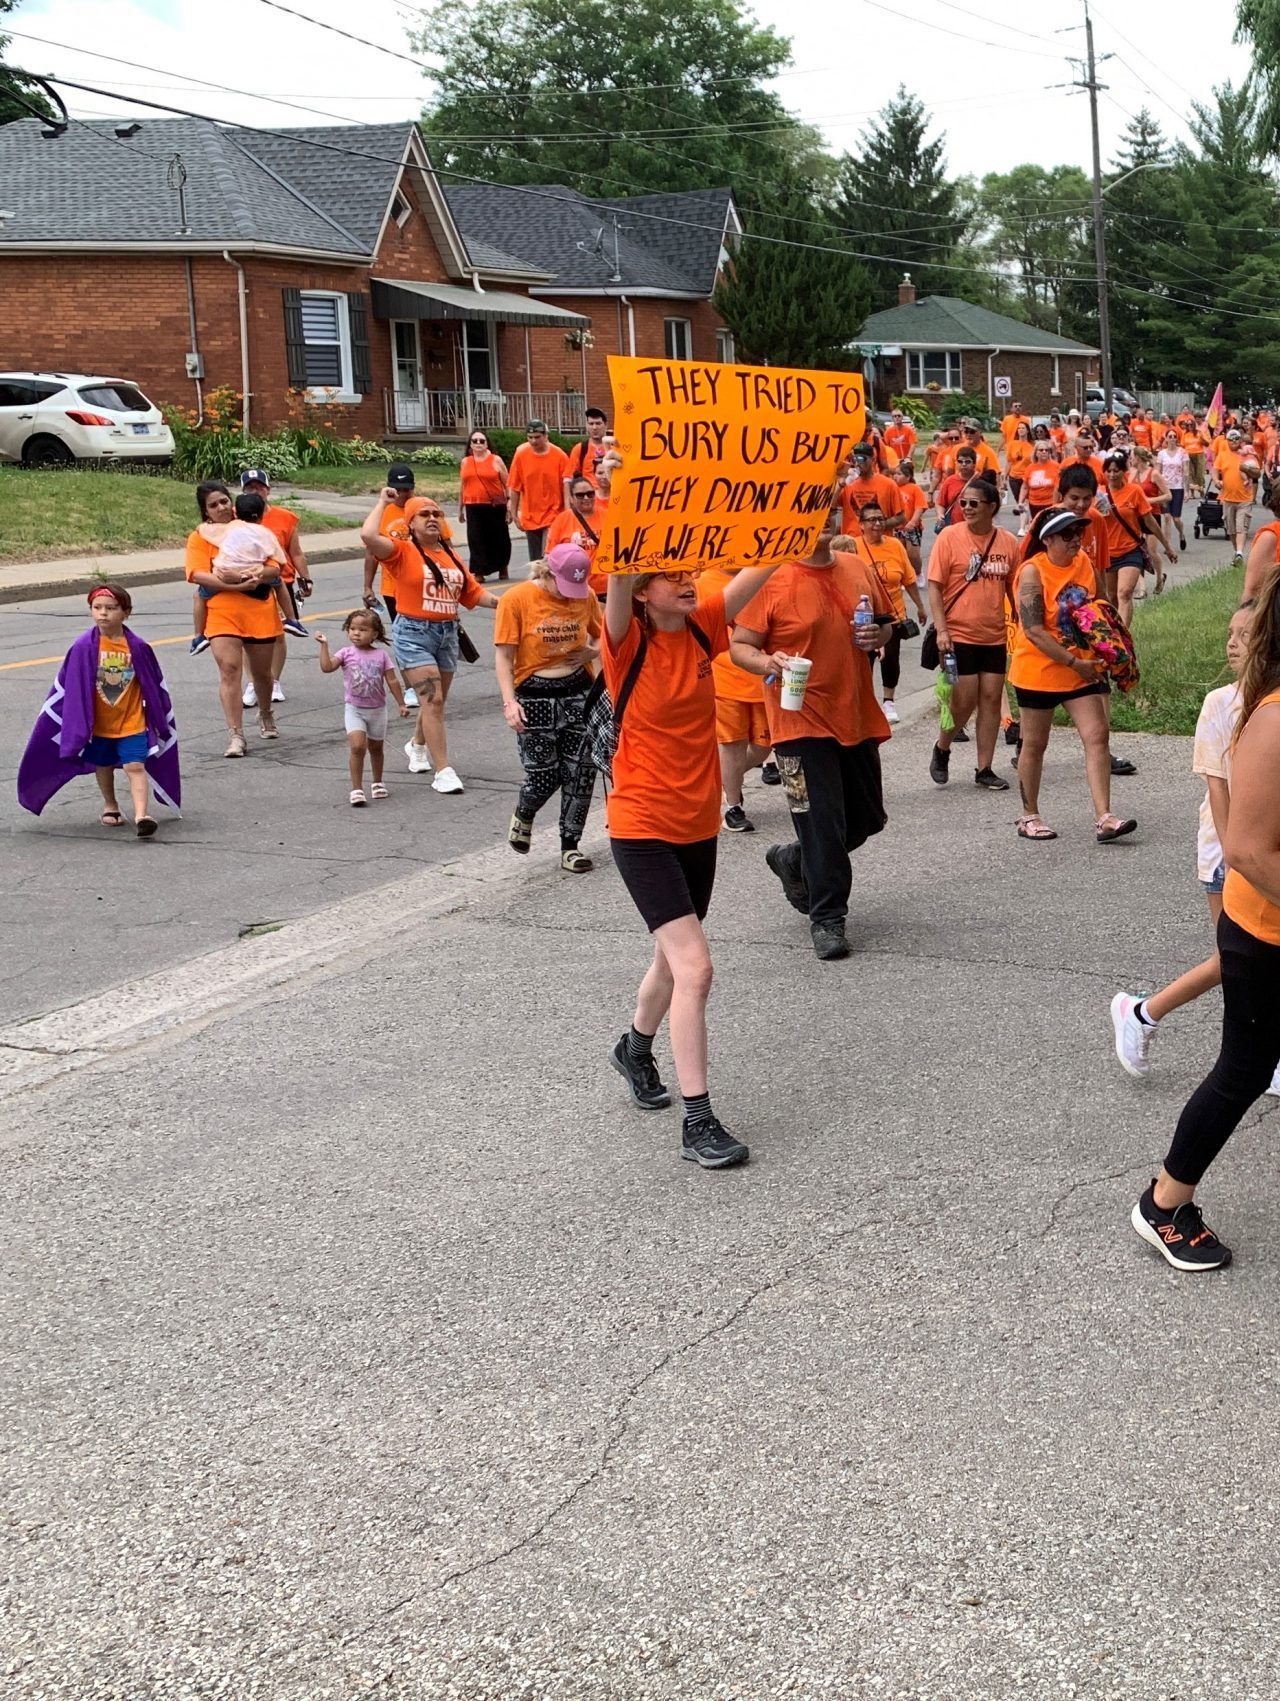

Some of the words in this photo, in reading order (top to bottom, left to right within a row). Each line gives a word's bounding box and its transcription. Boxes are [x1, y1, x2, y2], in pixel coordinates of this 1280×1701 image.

[637, 365, 722, 406] THEY
[735, 371, 817, 415] TRIED
[826, 383, 860, 415] TO
[640, 416, 729, 462] BURY
[741, 425, 780, 465] US
[791, 431, 850, 465] BUT
[629, 474, 700, 514] THEY
[703, 476, 791, 514] DIDNT
[612, 523, 657, 566] WE
[663, 523, 739, 561] WERE
